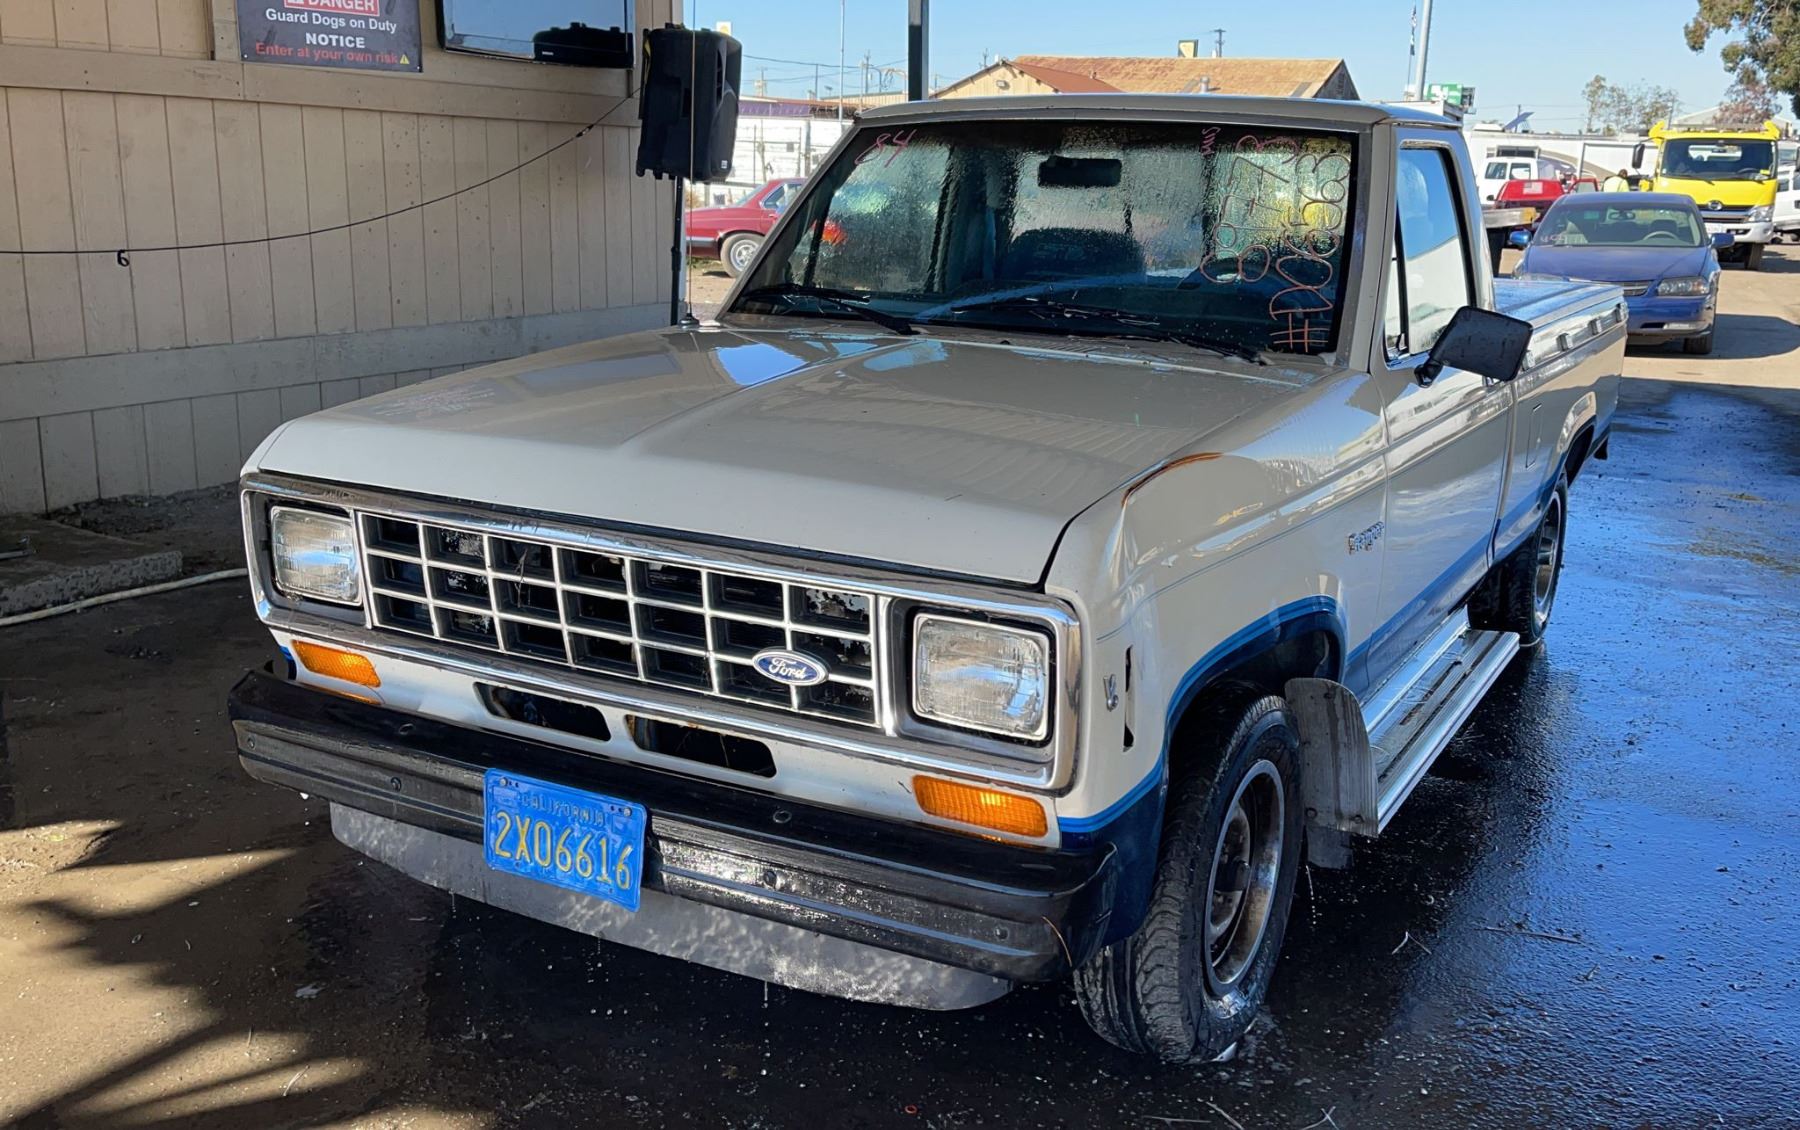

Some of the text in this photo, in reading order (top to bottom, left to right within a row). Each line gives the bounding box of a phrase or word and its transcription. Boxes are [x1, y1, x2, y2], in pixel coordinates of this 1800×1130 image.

[265, 8, 397, 34] Guard Dogs on Duty
[255, 42, 398, 64] Enter at your own risk
[305, 33, 366, 48] NOTICE
[854, 129, 917, 168] 84
[769, 658, 807, 679] Ford
[521, 794, 605, 827] CALIFORNIA
[494, 811, 634, 890] 2X06616
